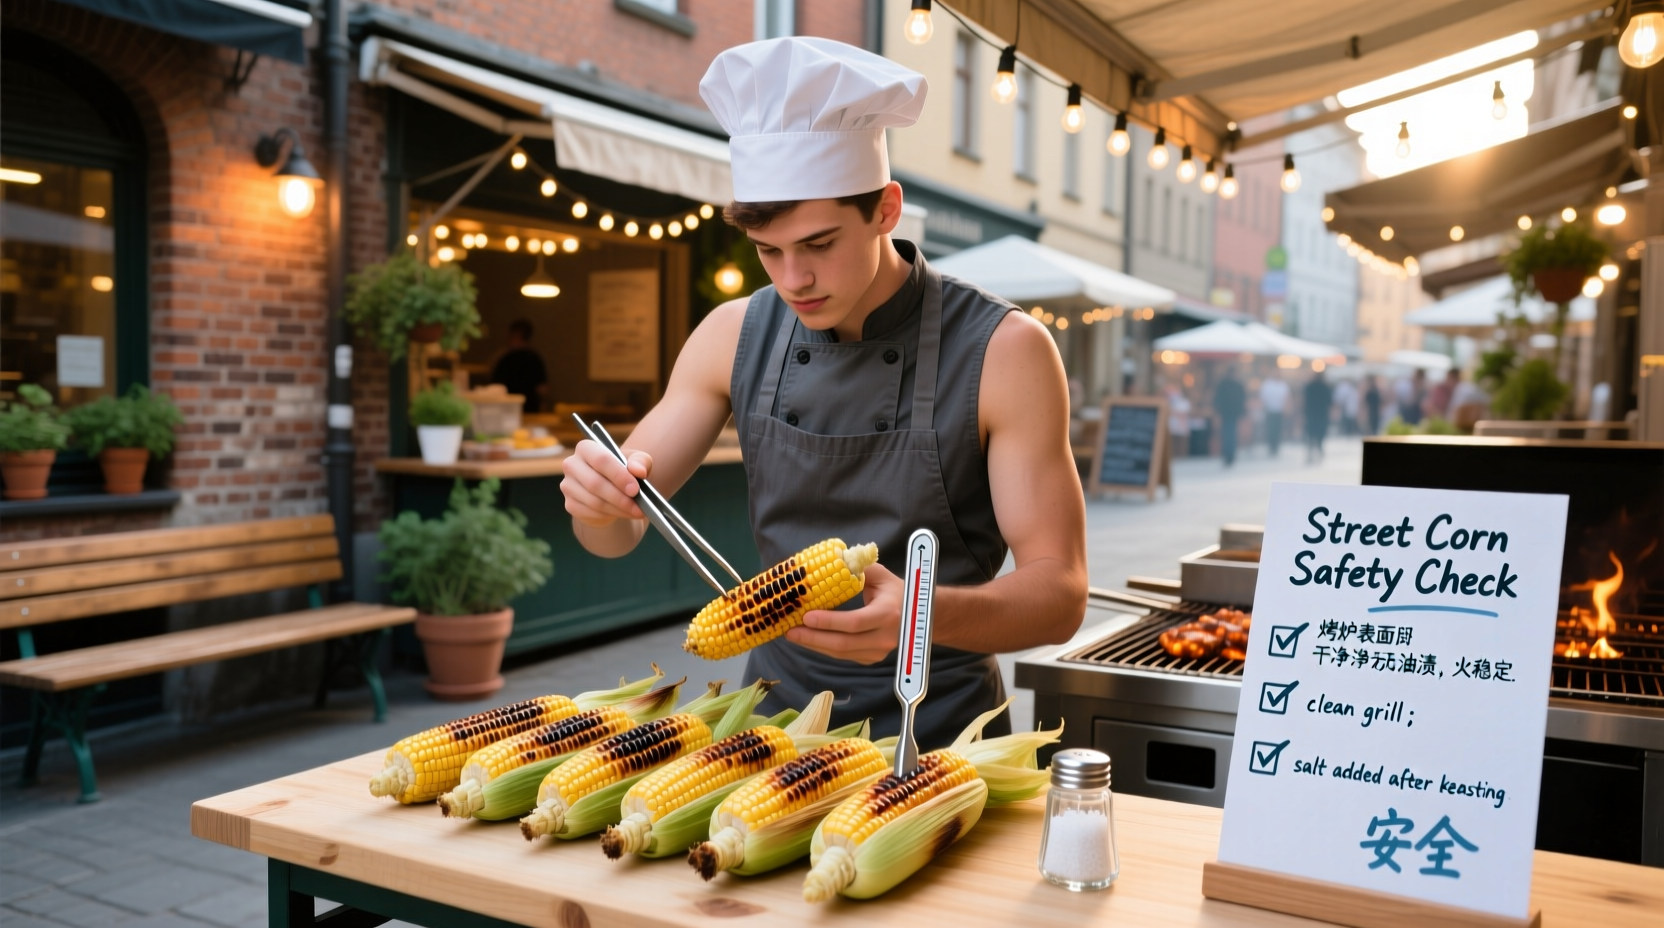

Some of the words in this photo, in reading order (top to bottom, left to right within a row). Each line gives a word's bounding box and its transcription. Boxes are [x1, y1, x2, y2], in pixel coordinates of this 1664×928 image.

[1302, 506, 1414, 548] Street
[1425, 513, 1509, 553] Corn
[1289, 550, 1404, 603] Safety
[1415, 558, 1518, 598] Check
[1306, 693, 1354, 717] clean
[1293, 756, 1327, 777] salt
[1333, 761, 1384, 785] added
[1389, 768, 1433, 791] after
[1360, 807, 1479, 879] 安全
